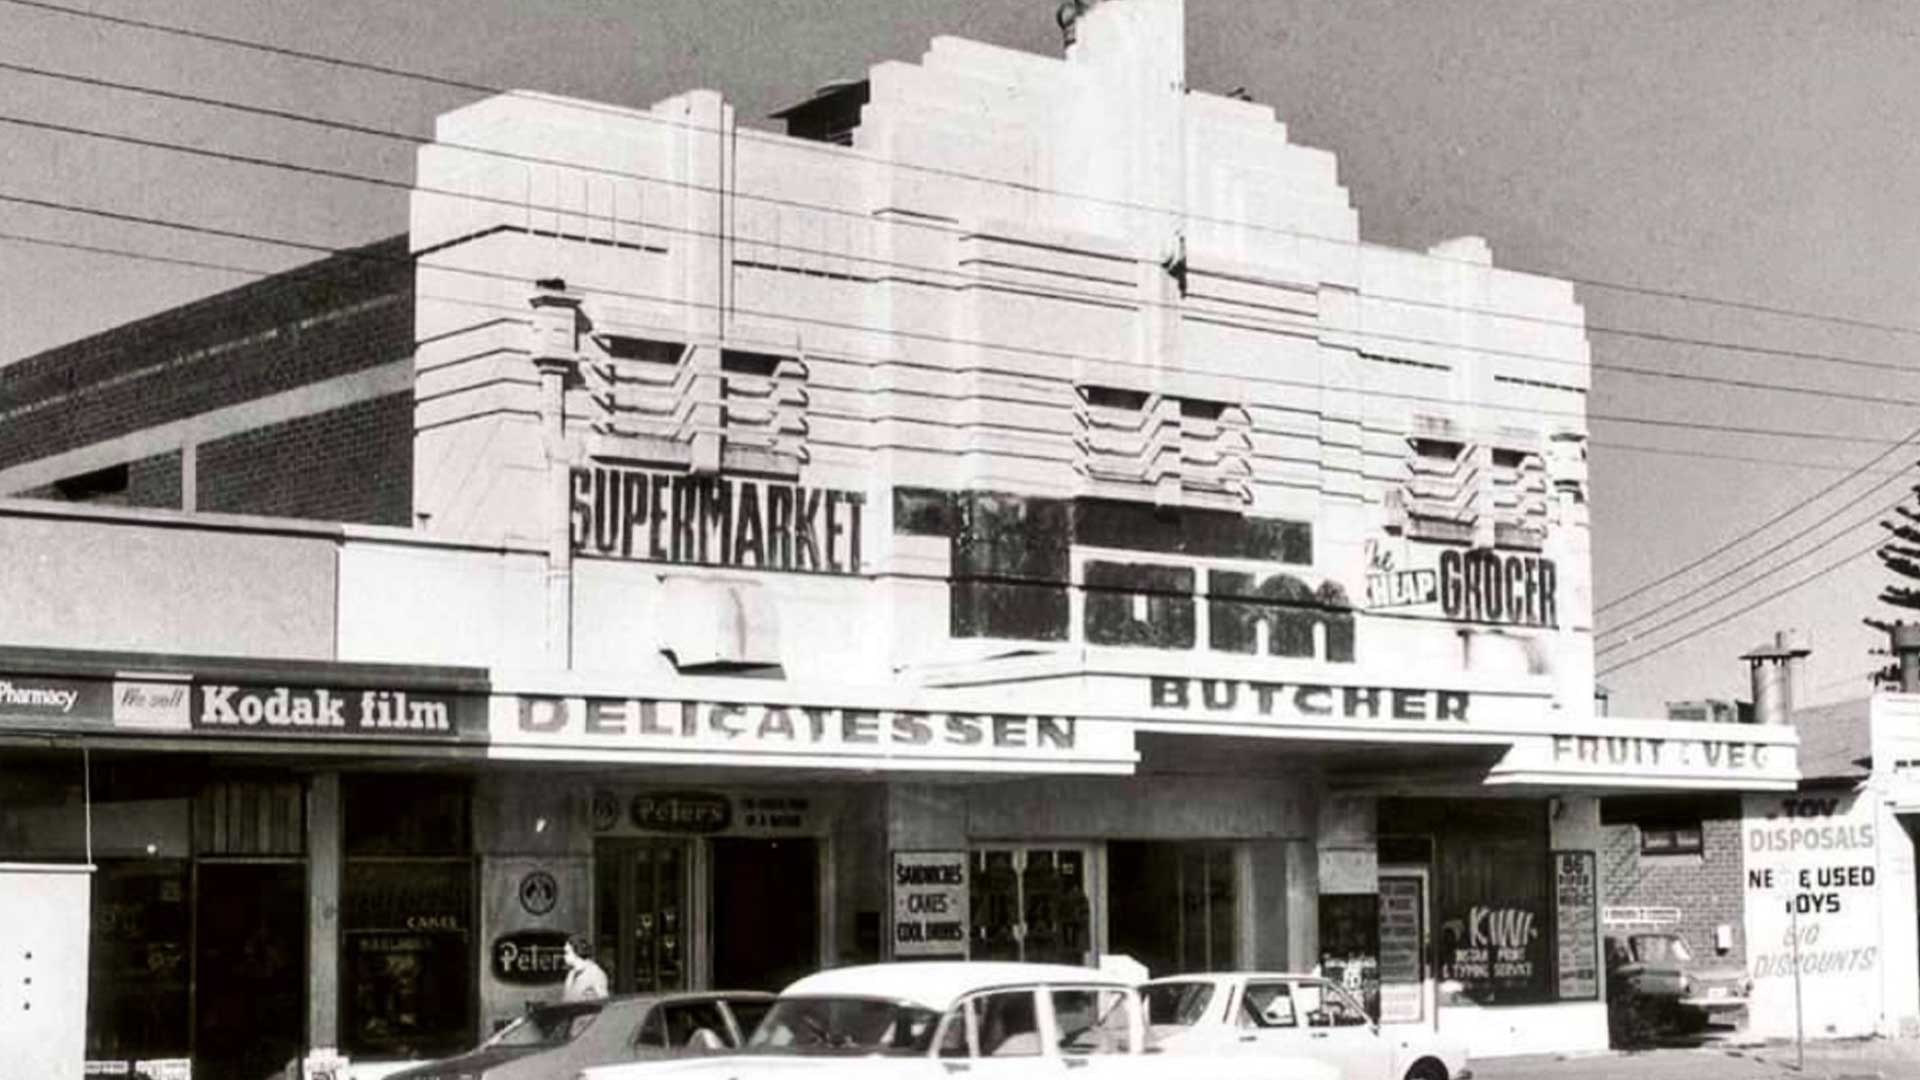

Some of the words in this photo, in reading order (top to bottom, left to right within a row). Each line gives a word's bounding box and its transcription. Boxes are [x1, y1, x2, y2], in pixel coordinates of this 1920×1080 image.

[569, 466, 867, 573] SUPERMARKET
[1440, 549, 1558, 627] GROCER
[0, 680, 78, 713] Pharmacy
[200, 685, 346, 727] Kodak
[360, 690, 451, 730] film
[1150, 676, 1470, 723] BUTCHER
[517, 694, 1077, 749] DELICATESSEN
[1551, 734, 1666, 766] FRUIT
[637, 797, 726, 824] Peters
[1750, 825, 1876, 853] DISPOSALS
[1817, 865, 1875, 888] USED
[907, 893, 949, 914] CAKES
[1469, 906, 1535, 948] KIWI
